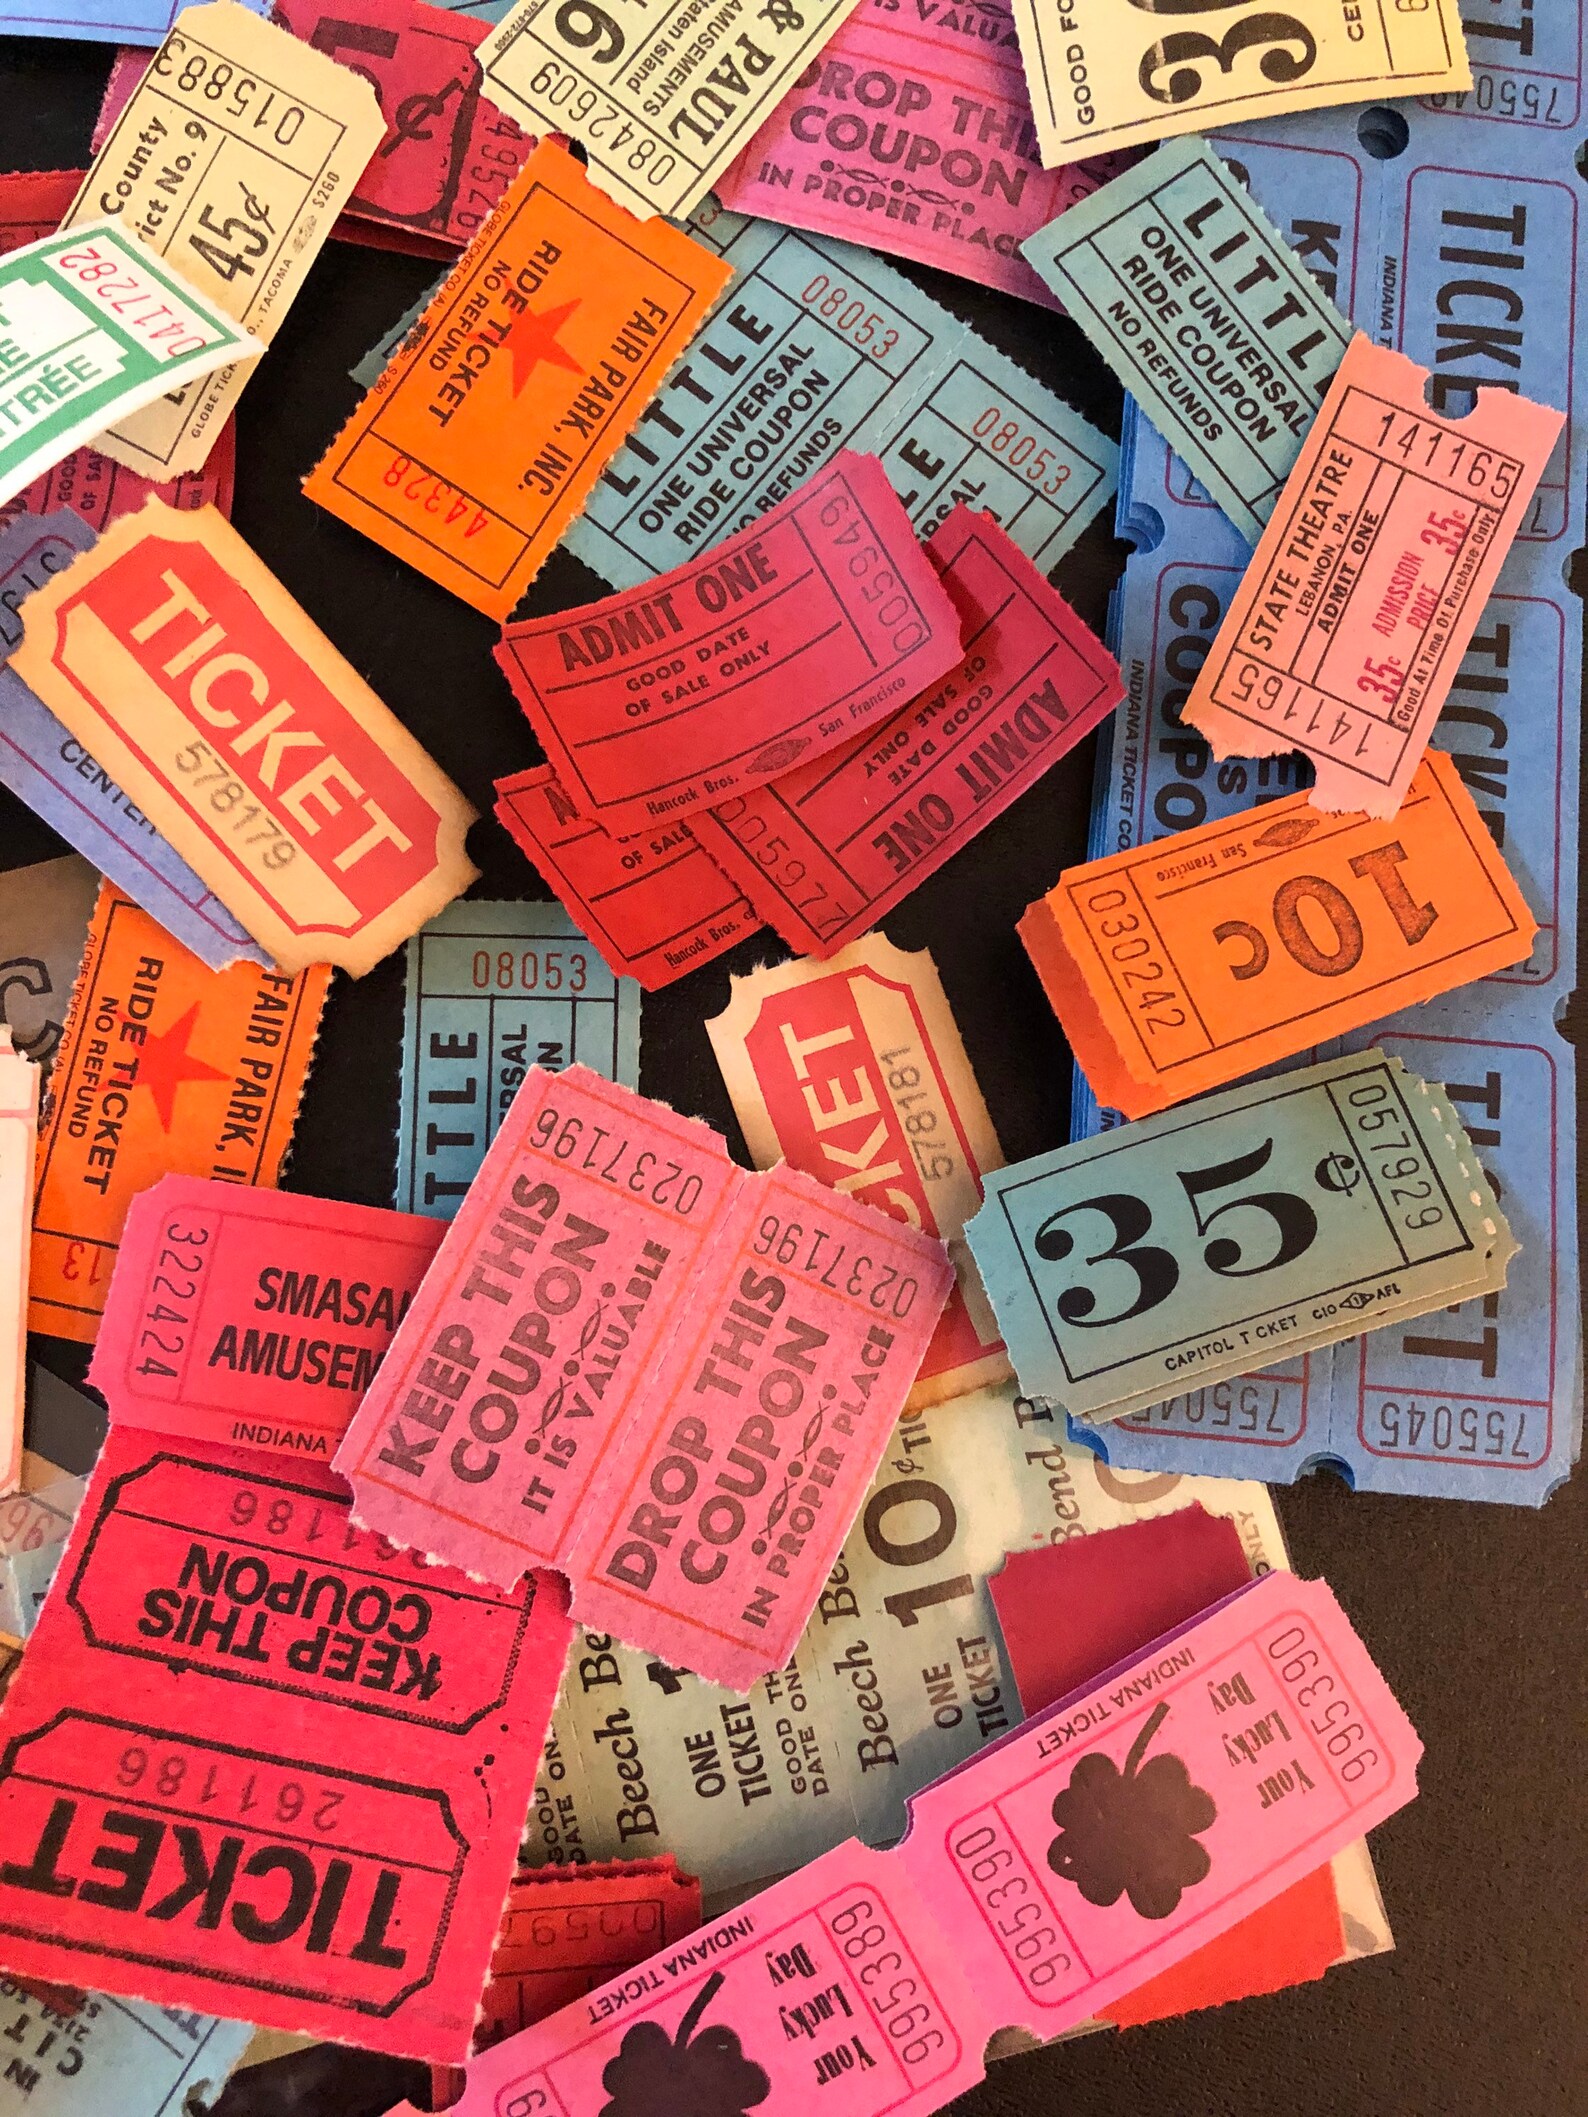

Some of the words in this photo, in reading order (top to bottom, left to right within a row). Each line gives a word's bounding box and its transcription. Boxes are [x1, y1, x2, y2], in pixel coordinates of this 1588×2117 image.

[155, 38, 305, 145] 015883
[626, 45, 675, 94] Island
[643, 0, 745, 116] AMUSEMENTS
[668, 33, 776, 146] PAUL
[1067, 43, 1095, 125] GOOD
[100, 116, 167, 215] County
[155, 151, 197, 195] No.
[184, 120, 208, 142] 9
[530, 62, 676, 186] 0842609
[790, 105, 1028, 207] COUPON
[758, 161, 794, 190] IN
[803, 174, 921, 226] PROPER
[258, 258, 293, 315] TACOMA
[462, 237, 487, 275] TICKET
[483, 259, 512, 290] NO
[501, 239, 562, 314] RIDE
[1380, 255, 1397, 331] INDIANA
[59, 247, 207, 357] 0417282
[428, 291, 489, 372] REFUND
[610, 297, 669, 364] FAIR
[802, 275, 899, 359] 08053
[1141, 226, 1194, 287] ONE
[1188, 287, 1311, 437] UNIVERSAL
[428, 318, 513, 427] TICKET
[1108, 302, 1139, 337] NO
[1137, 340, 1223, 442] REFUNDS
[1121, 254, 1182, 324] RIDE
[1176, 325, 1277, 443] COUPON
[191, 395, 219, 438] GLOBE
[553, 361, 627, 440] PARK,
[600, 304, 774, 497] LITTLE
[638, 475, 695, 533] ONE
[687, 343, 815, 477] UNIVERSAL
[518, 443, 574, 496] INC.
[672, 478, 737, 545] RIDE
[730, 368, 830, 480] COUPON
[755, 417, 842, 514] REFUNDS
[972, 407, 1072, 495] 08053
[1377, 411, 1518, 499] 141165
[382, 455, 489, 539] 44328
[1250, 568, 1301, 651] STATE
[1287, 448, 1353, 568] THEATRE
[1318, 564, 1357, 634] ADMIT
[1353, 509, 1382, 555] ONE
[557, 593, 684, 673] ADMIT
[695, 542, 778, 613] ONE
[1372, 551, 1424, 638] ADMISSION
[1397, 687, 1421, 727] Good
[1414, 664, 1429, 684] At
[1423, 633, 1444, 665] Time
[1444, 546, 1479, 608] Purchase
[1407, 582, 1439, 631] PRICE
[625, 698, 651, 717] OF
[661, 675, 709, 705] SALE
[719, 641, 770, 678] ONLY
[626, 660, 686, 692] GOOD
[697, 627, 750, 662] DATE
[963, 655, 986, 682] OF
[1126, 659, 1144, 739] INDIANA
[129, 568, 413, 872] TICKET
[646, 788, 700, 817] Hancock
[704, 774, 739, 794] Bros.
[818, 721, 844, 738] San
[848, 676, 906, 721] Francisco
[914, 685, 958, 728] SALE
[943, 684, 994, 737] GOOD
[955, 676, 1070, 803] ADMIT
[1231, 664, 1372, 757] 141165
[862, 735, 910, 779] ONLY
[889, 743, 933, 788] DATE
[1120, 743, 1138, 813] TICKET
[175, 741, 296, 869] 578179
[871, 793, 956, 874] ONE
[621, 853, 644, 870] OF
[1156, 852, 1218, 882] Francisco
[1222, 844, 1247, 860] San
[472, 950, 588, 992] 08053
[665, 938, 708, 969] Hancock
[711, 922, 741, 941] Bros.
[1087, 888, 1187, 1035] 030242
[95, 996, 119, 1033] NO
[119, 956, 164, 1048] RIDE
[247, 972, 295, 1049] FAIR
[67, 1040, 108, 1139] REFUND
[84, 1057, 140, 1196] TICKET
[214, 1057, 272, 1152] PARK,
[880, 1046, 955, 1182] 578181
[530, 1108, 703, 1215] 0237196
[1349, 1085, 1443, 1231] 057929
[135, 1222, 209, 1378] 322424
[254, 1267, 408, 1332] SMASA
[753, 1215, 919, 1318] 0237196
[208, 1325, 383, 1393] AMUSEM
[378, 1325, 481, 1477] KEEP
[461, 1173, 559, 1305] THIS
[451, 1213, 609, 1484] COUPON
[1164, 1339, 1235, 1373] CAPITOL
[1312, 1303, 1337, 1321] CIO
[521, 1476, 555, 1514] IT
[544, 1435, 578, 1470] IS
[565, 1239, 672, 1419] VALUABLE
[232, 1422, 327, 1454] INDIANA
[605, 1415, 714, 1591] DROP
[694, 1266, 787, 1397] THIS
[681, 1316, 830, 1585] COUPON
[1380, 1402, 1530, 1457] 755045
[740, 1592, 780, 1629] IN
[766, 1447, 844, 1578] PROPER
[831, 1324, 896, 1436] PLACE
[138, 1589, 270, 1662] THIS
[177, 1543, 432, 1642] COUPON
[287, 1627, 442, 1701] KEEP
[922, 1662, 964, 1729] ONE
[956, 1636, 1009, 1738] TICKET
[1110, 1648, 1196, 1709] INDIANA
[1207, 1672, 1258, 1714] Day
[1269, 1627, 1379, 1782] 995390
[833, 1640, 899, 1773] Beech
[1037, 1704, 1111, 1760] TICKET
[1224, 1711, 1294, 1767] Lucky
[116, 1746, 345, 1831] 261186
[593, 1707, 660, 1843] Beech
[683, 1730, 726, 1798] ONE
[720, 1703, 772, 1807] TICKET
[776, 1718, 807, 1795] GOOD
[798, 1726, 829, 1797] DATE
[1258, 1760, 1316, 1809] Your
[0, 1798, 407, 1969] TICKET
[956, 1827, 1071, 1987] 995390
[666, 1917, 756, 1980] INDIANA
[767, 1943, 818, 1987] Day
[832, 1900, 945, 2064] 995389
[587, 1975, 664, 2027] TICKET
[779, 1983, 855, 2041] Lucky
[815, 2035, 877, 2087] Your
